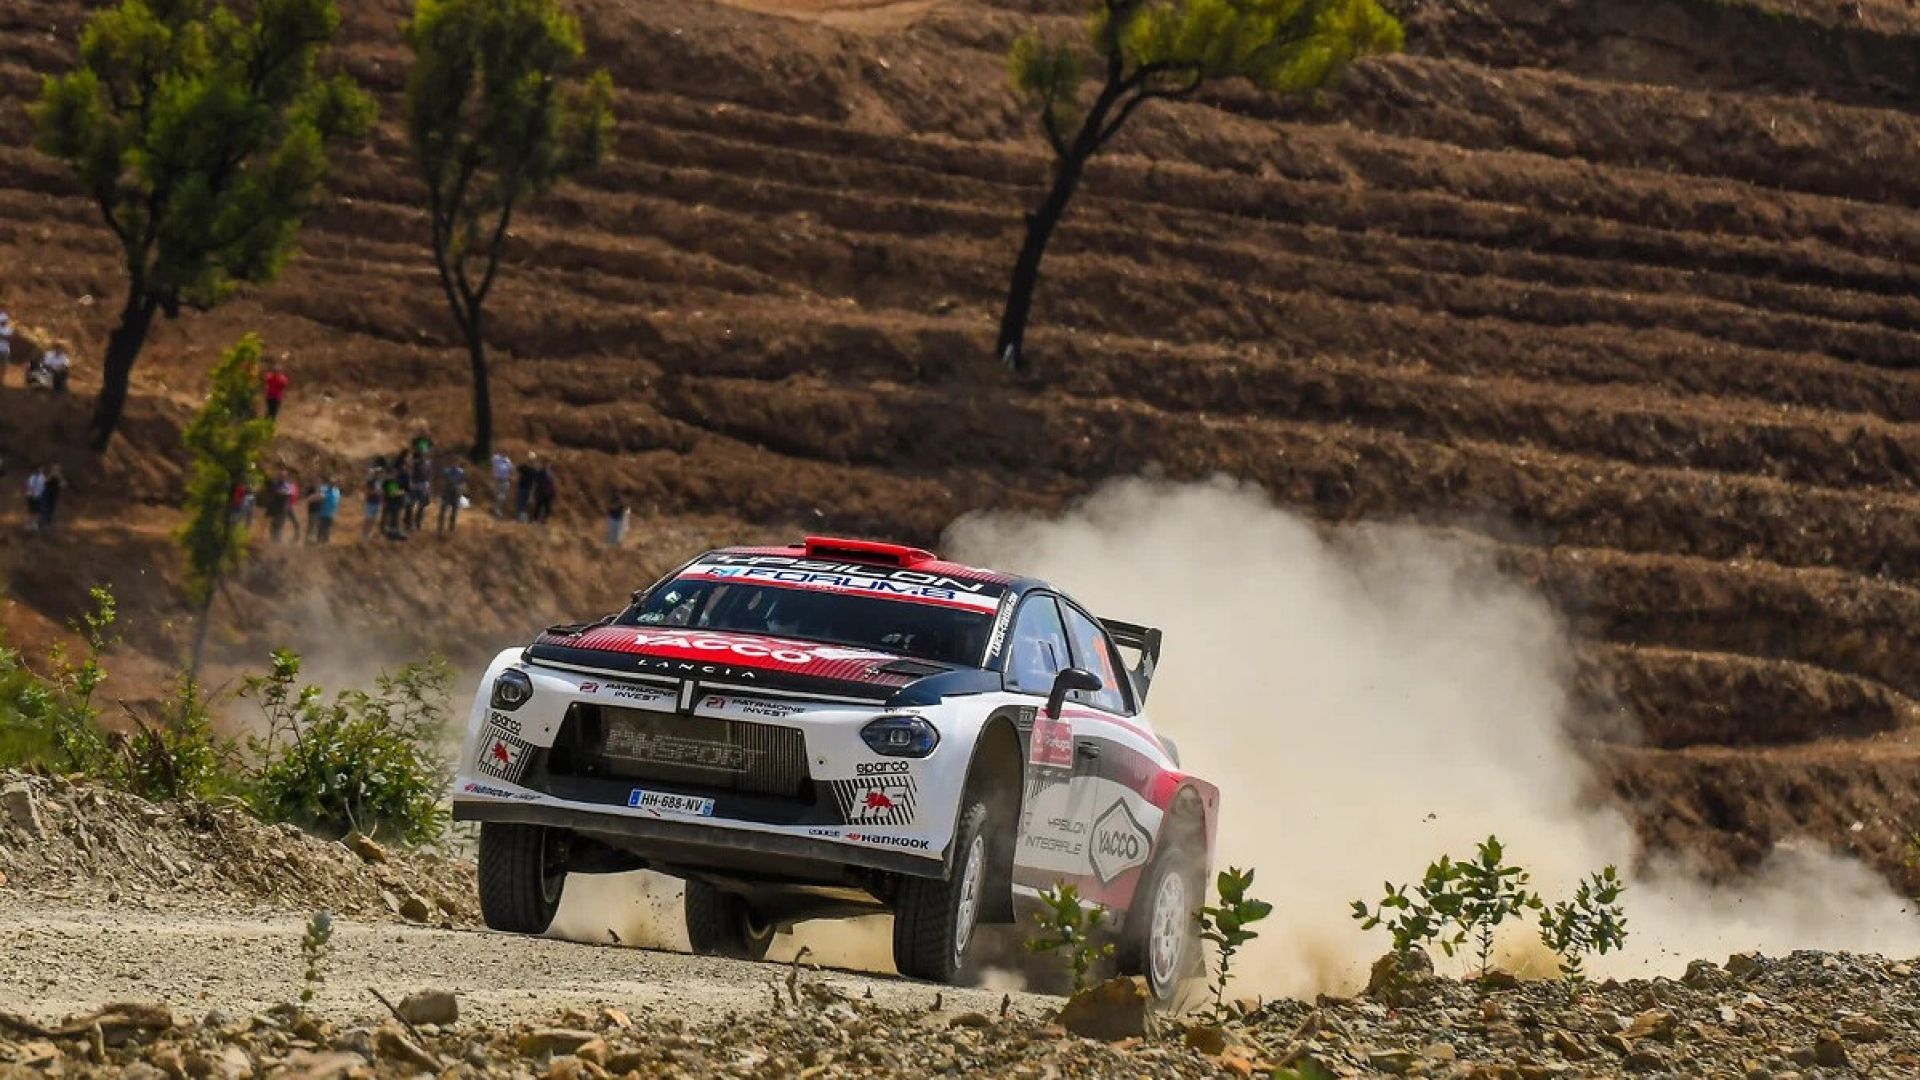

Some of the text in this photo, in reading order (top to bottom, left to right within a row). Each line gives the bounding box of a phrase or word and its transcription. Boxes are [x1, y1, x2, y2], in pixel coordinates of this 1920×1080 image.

[634, 634, 812, 663] YACCO
[638, 659, 756, 679] LANCIA
[743, 706, 788, 717] INVEST
[856, 761, 909, 775] sparco
[1099, 829, 1138, 860] YACCO
